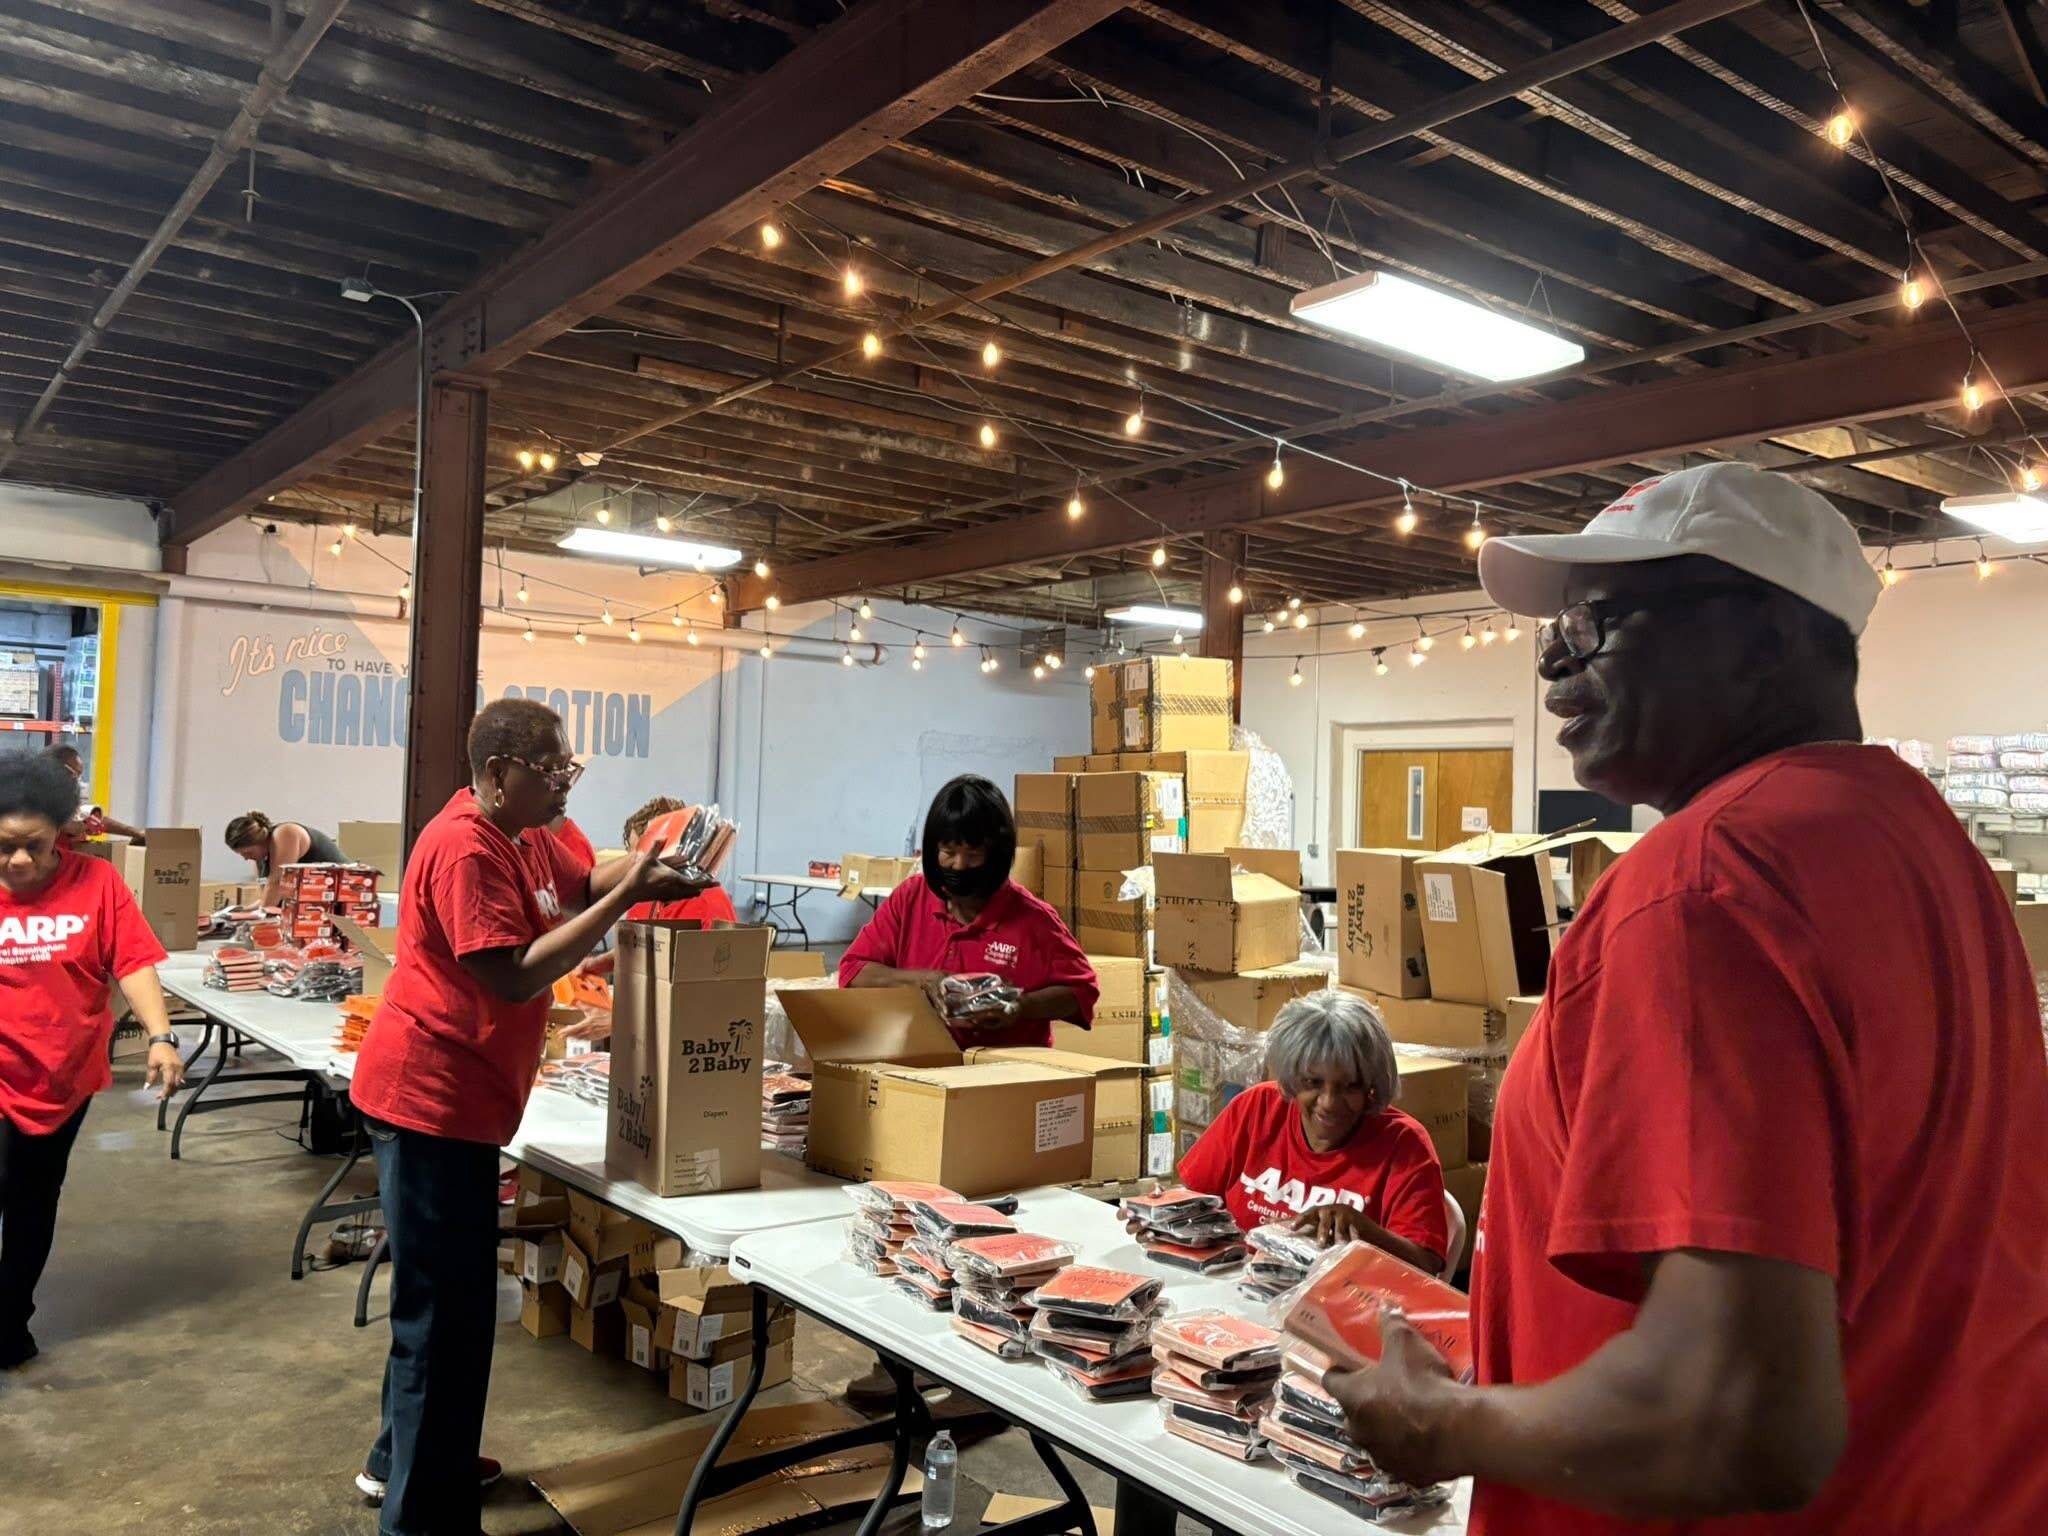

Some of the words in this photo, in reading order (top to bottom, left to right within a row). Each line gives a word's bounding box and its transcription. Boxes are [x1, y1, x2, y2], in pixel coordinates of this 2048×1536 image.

[222, 634, 277, 697] It's
[285, 626, 349, 663] nice
[327, 658, 346, 672] TO
[354, 660, 392, 674] HAVE
[503, 685, 652, 759] ATION
[0, 914, 84, 946] ARP
[987, 941, 1017, 954] AARP
[682, 1038, 731, 1057] Baby
[617, 1088, 642, 1127] Baby
[703, 1109, 728, 1119] Diapers
[1247, 1200, 1279, 1218] Central
